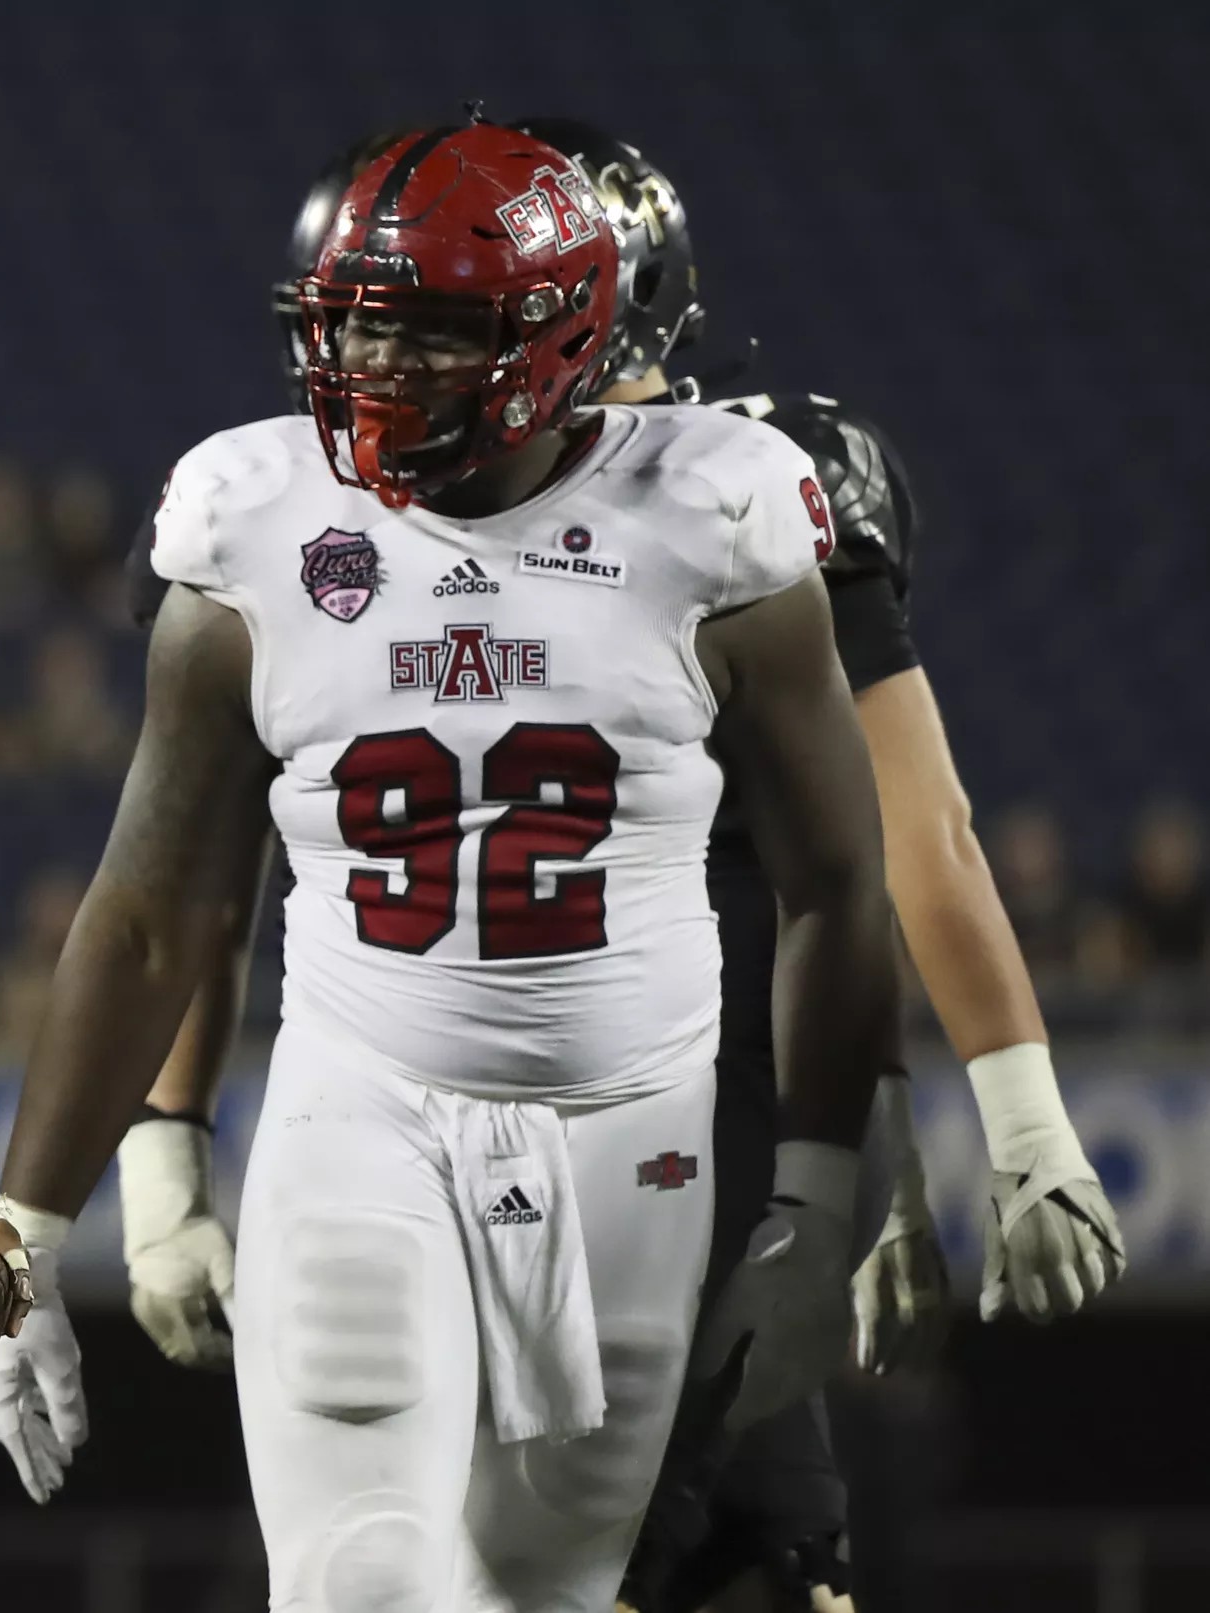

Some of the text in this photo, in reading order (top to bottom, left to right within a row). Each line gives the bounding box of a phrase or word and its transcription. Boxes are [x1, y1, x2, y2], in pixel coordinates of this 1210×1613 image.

[799, 476, 836, 562] 9
[433, 577, 500, 597] adidas
[524, 553, 621, 578] SUN BELT
[390, 624, 550, 702] STATE
[330, 721, 621, 960] 92
[487, 1209, 543, 1225] adidas
